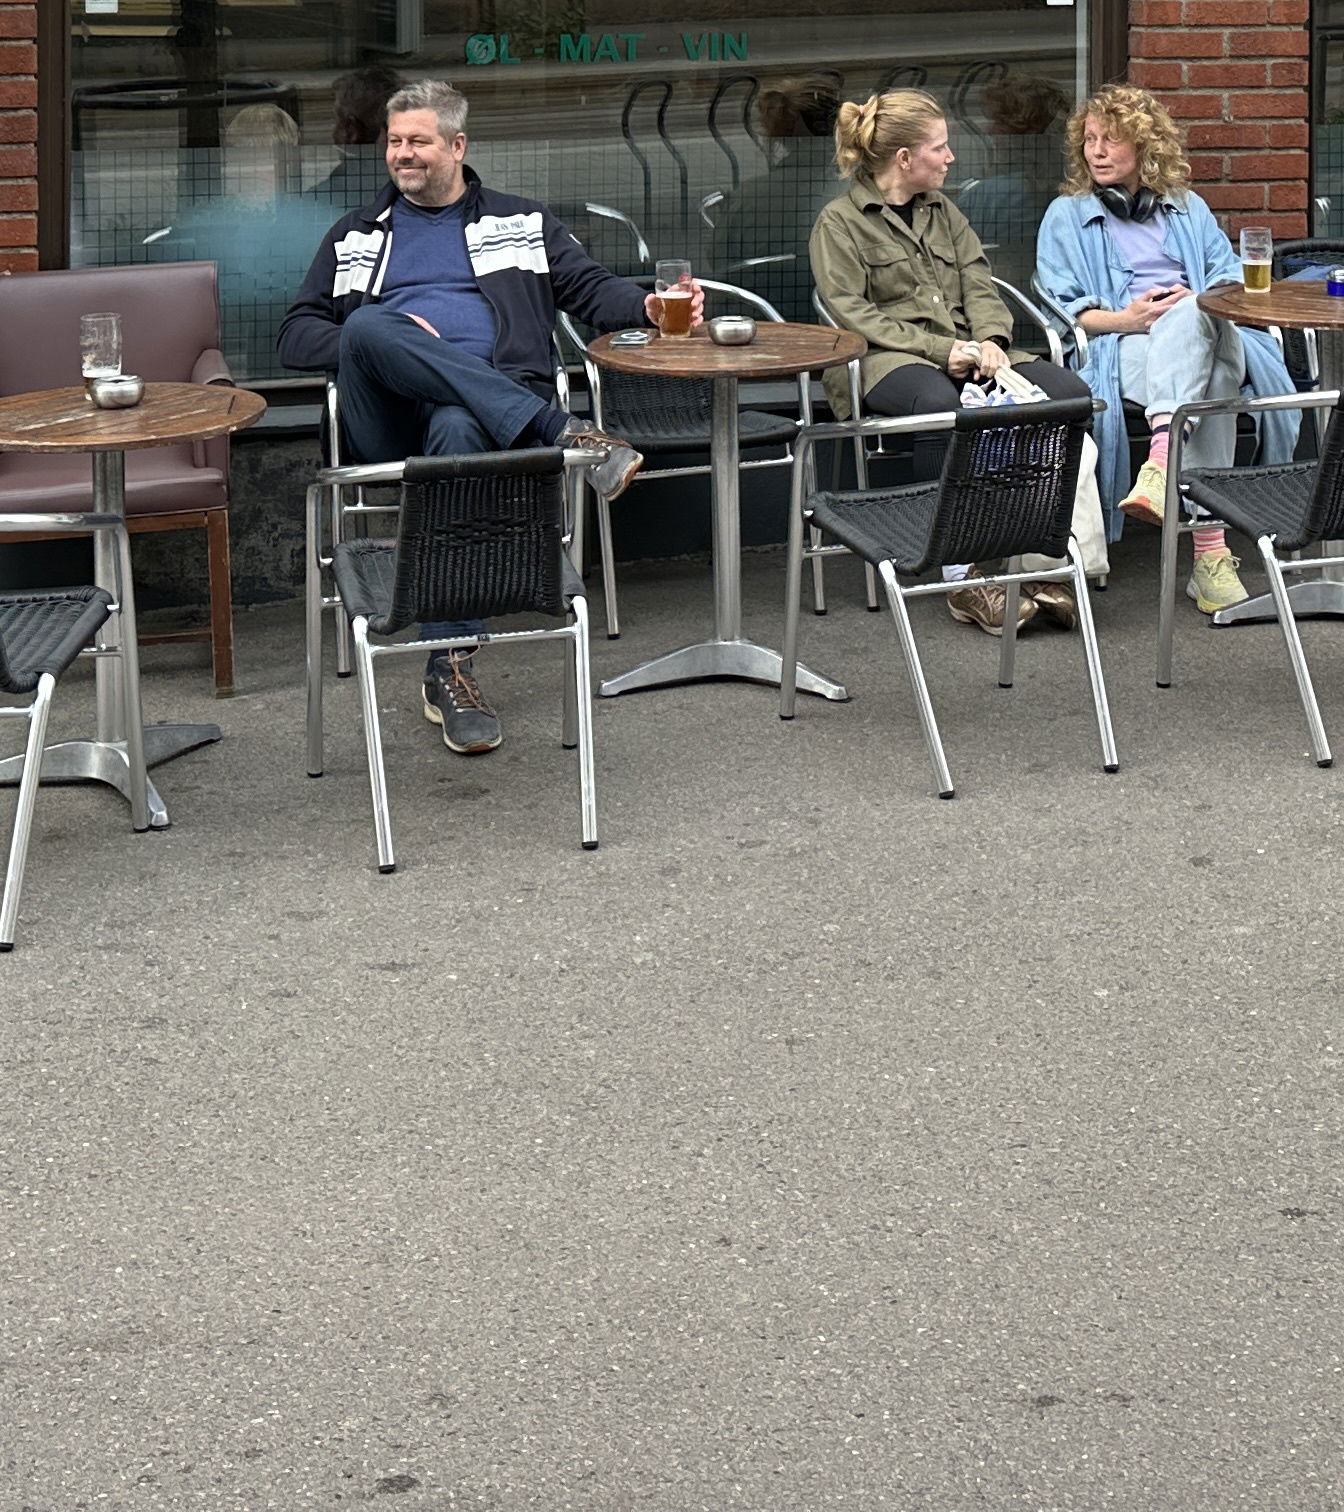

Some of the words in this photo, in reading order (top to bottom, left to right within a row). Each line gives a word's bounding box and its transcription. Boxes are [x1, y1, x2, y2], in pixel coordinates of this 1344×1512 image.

[465, 33, 520, 64] ØL
[559, 32, 646, 64] MAT
[682, 31, 748, 62] VIN
